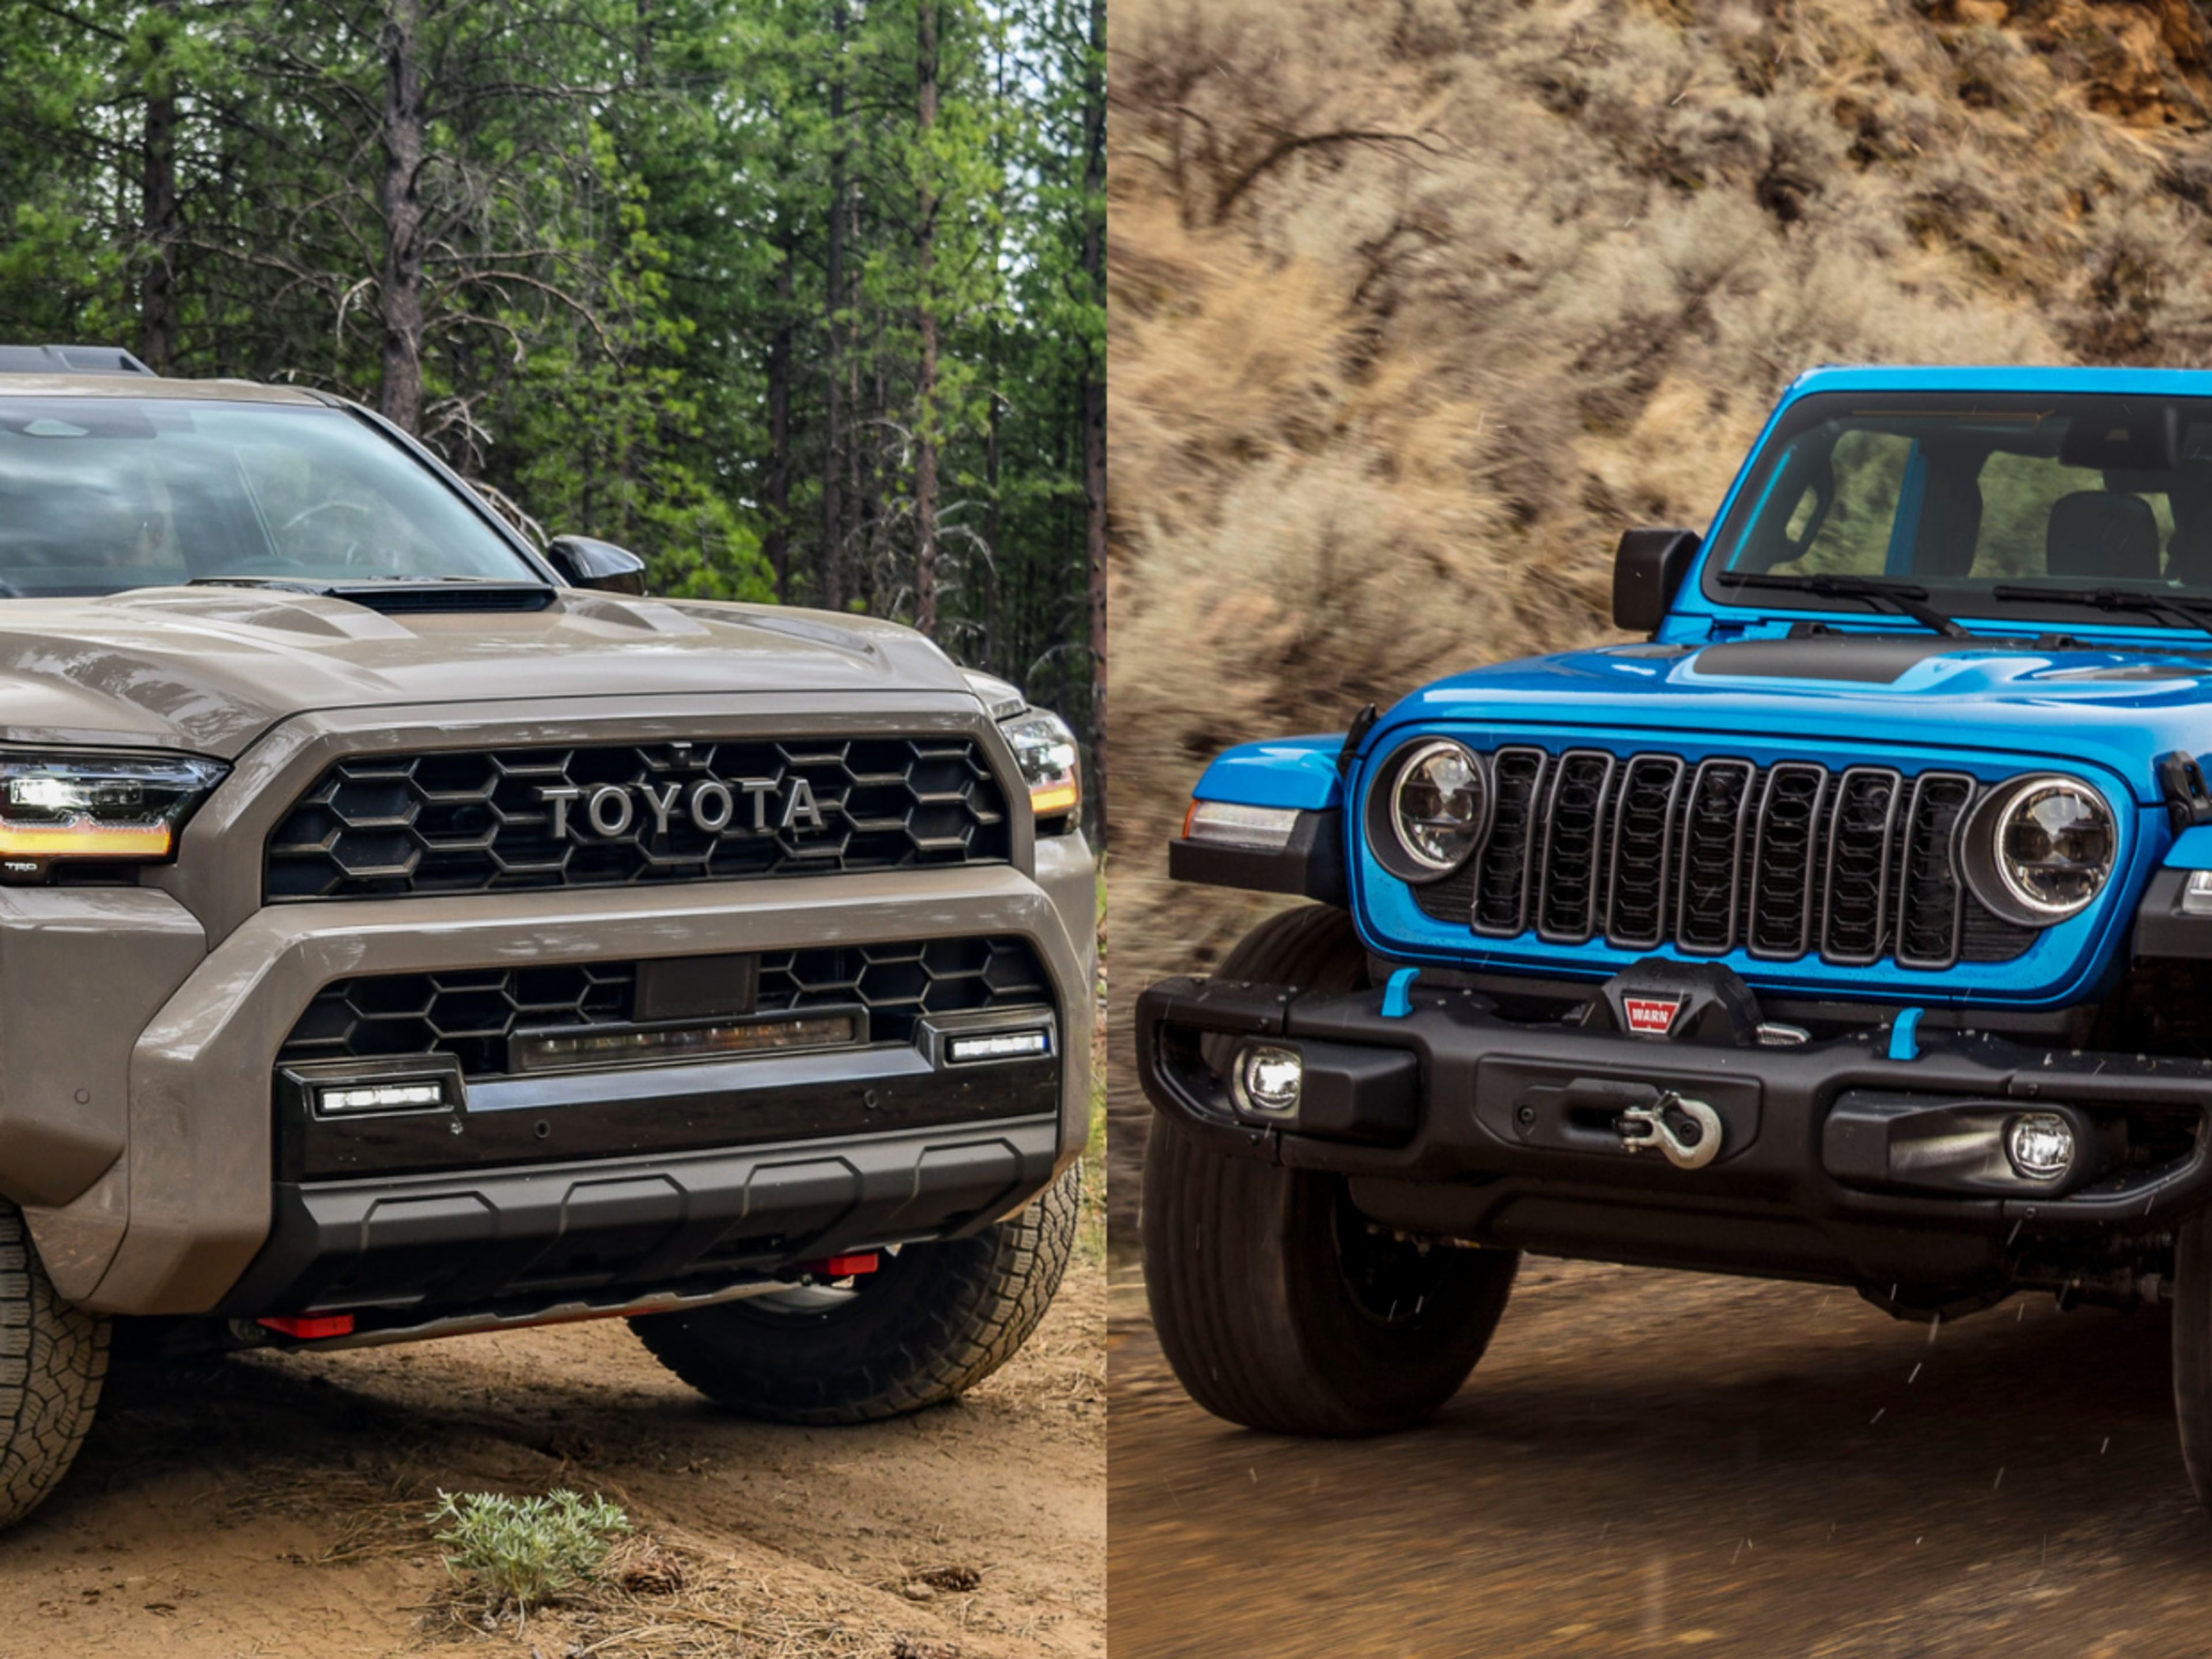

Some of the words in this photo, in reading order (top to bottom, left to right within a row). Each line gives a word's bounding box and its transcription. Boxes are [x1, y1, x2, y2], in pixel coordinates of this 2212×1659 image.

[538, 777, 823, 838] TOYOTA
[5, 862, 37, 872] TRD
[1632, 1008, 1669, 1023] WARN
